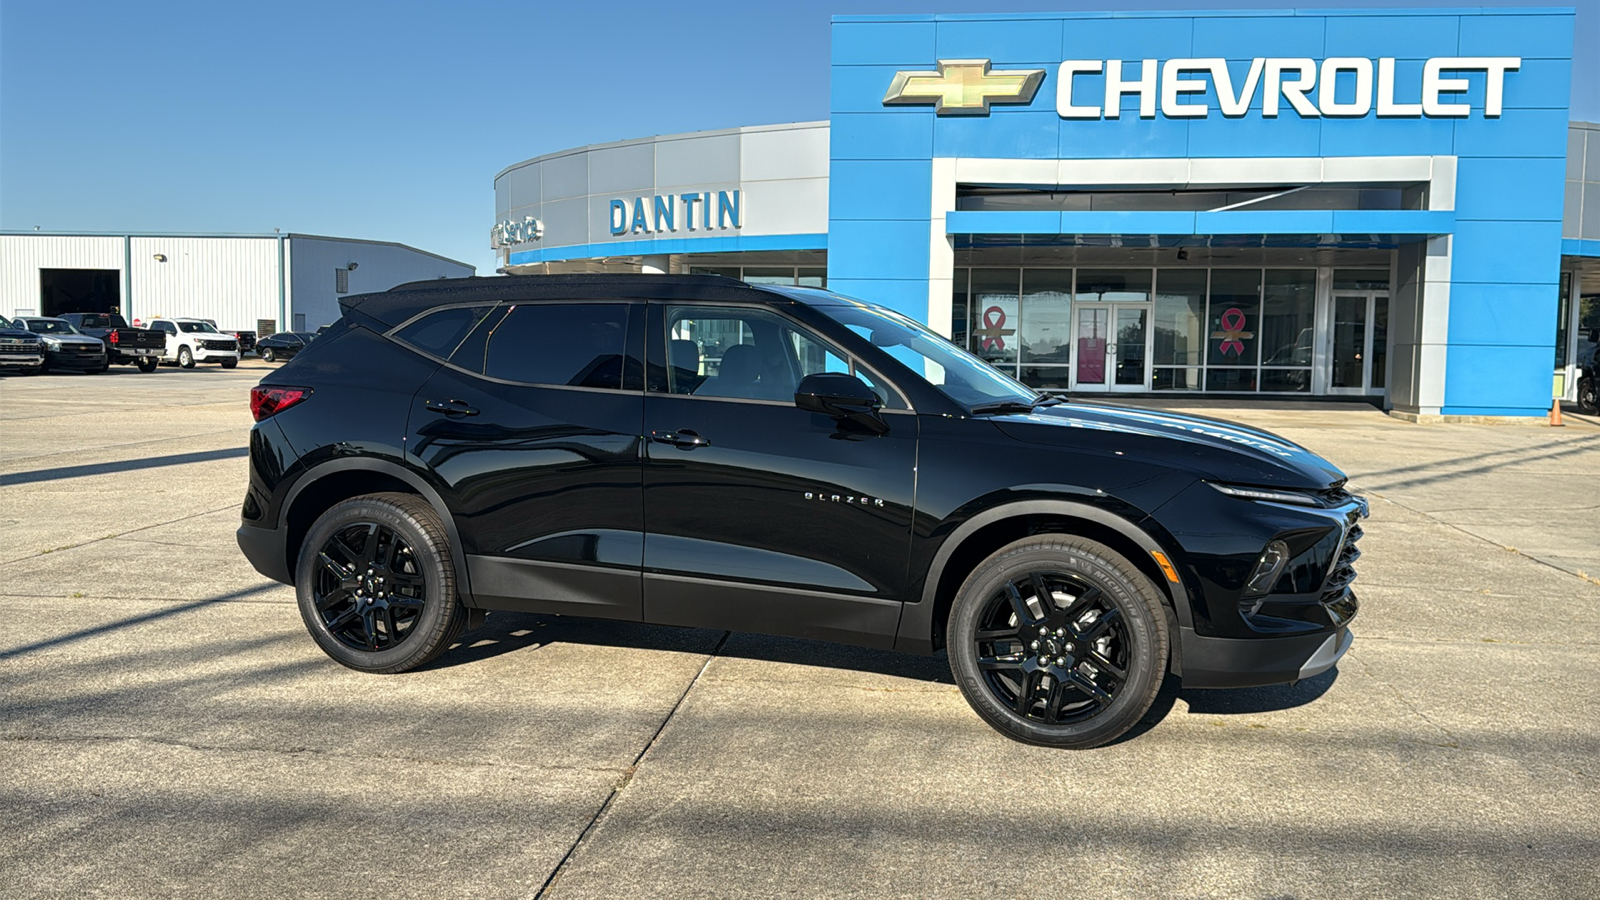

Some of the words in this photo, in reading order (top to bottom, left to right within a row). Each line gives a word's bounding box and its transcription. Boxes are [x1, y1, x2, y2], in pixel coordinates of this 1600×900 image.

[1056, 57, 1521, 119] CHEVROLET
[505, 216, 540, 243] Service
[610, 190, 741, 235] DANTIN
[804, 492, 884, 507] BLAZER
[1093, 571, 1138, 617] MICHELIN
